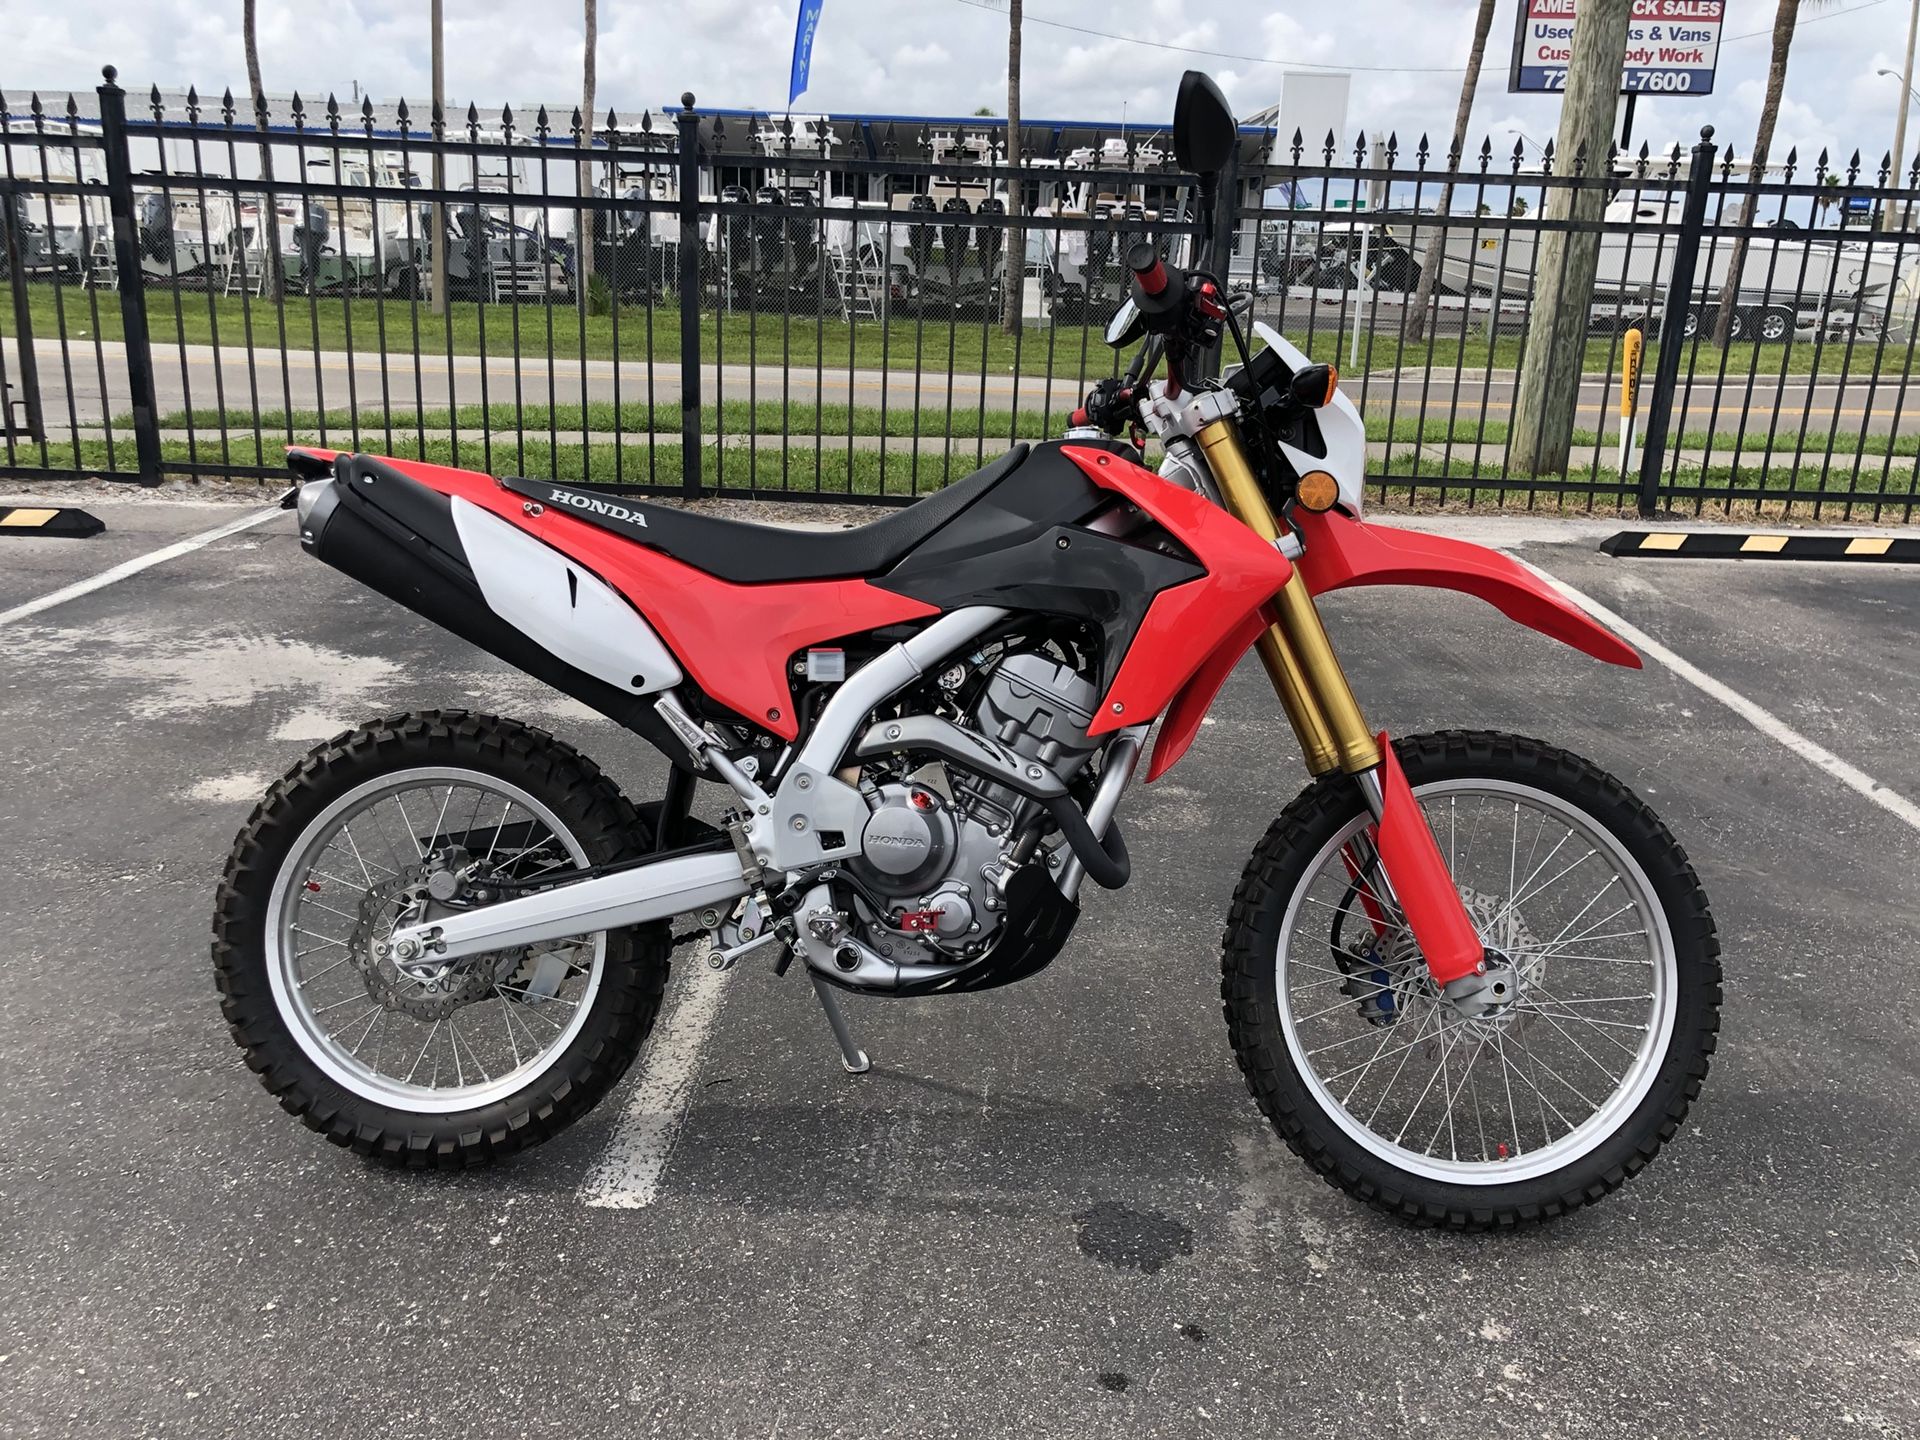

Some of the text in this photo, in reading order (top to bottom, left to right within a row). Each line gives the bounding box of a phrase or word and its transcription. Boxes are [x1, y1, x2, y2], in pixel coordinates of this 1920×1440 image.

[1662, 0, 1720, 16] SALES
[1649, 26, 1662, 40] &
[1669, 27, 1711, 41] Vans
[1624, 47, 1654, 65] ody
[1659, 48, 1704, 63] Work
[549, 489, 648, 528] HONDA
[868, 835, 926, 848] HONDA
